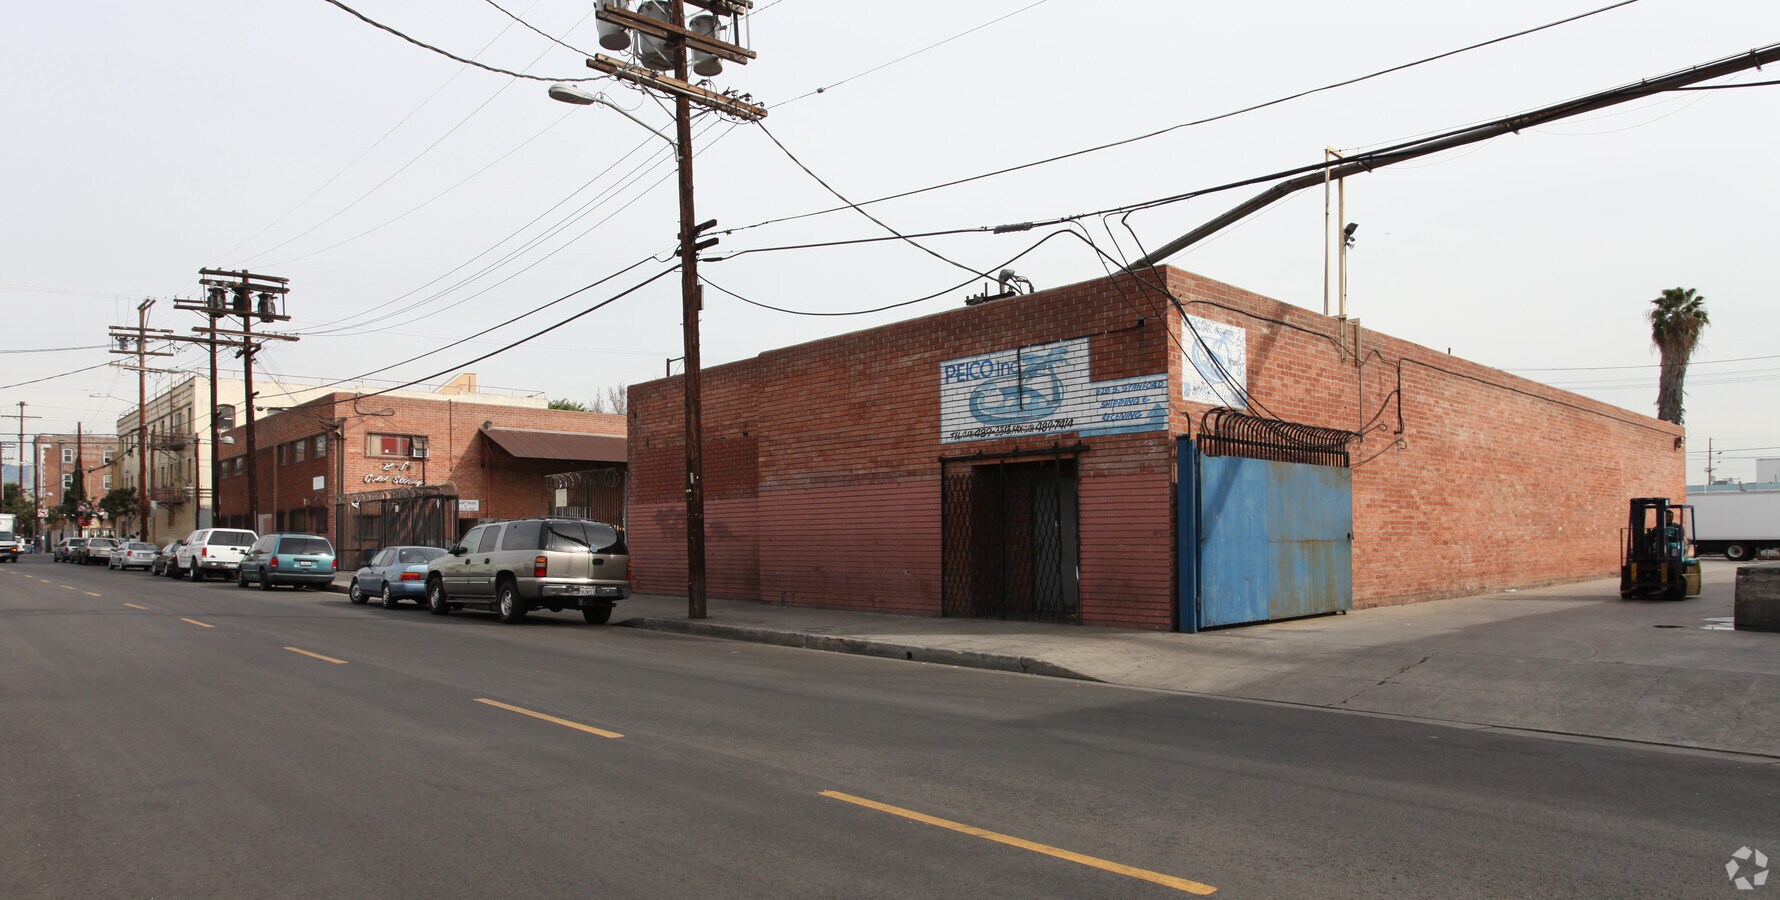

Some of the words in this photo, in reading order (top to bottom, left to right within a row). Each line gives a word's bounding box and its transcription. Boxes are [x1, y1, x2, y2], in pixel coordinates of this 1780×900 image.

[945, 359, 994, 384] PEICO
[1122, 381, 1164, 392] STANFORD
[1100, 397, 1139, 408] SHIPPING
[1102, 410, 1142, 421] RECEIVING
